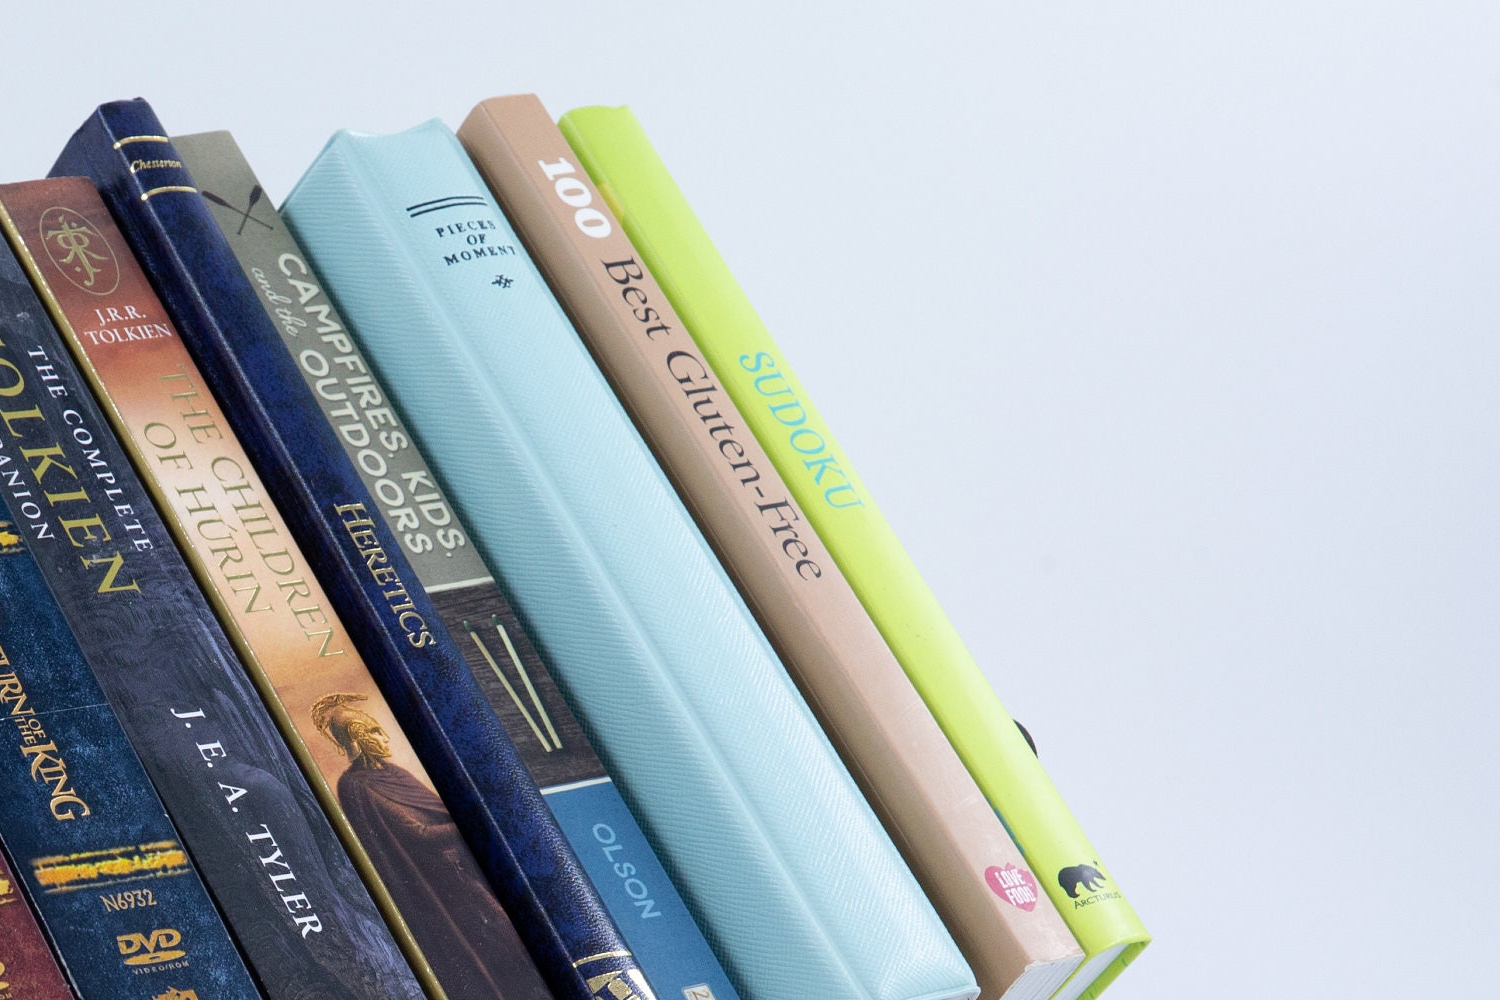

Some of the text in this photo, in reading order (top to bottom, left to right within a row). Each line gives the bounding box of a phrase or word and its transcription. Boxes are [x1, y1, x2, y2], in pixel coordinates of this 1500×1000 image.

[130, 159, 182, 174] Chesterton
[435, 220, 496, 238] PIECES
[466, 234, 486, 245] OF
[443, 245, 516, 266] MOMENT
[94, 305, 148, 326] J.R.R.
[84, 322, 174, 347] TOLKIEN
[537, 156, 822, 583] 100 Best Gluten-Free
[252, 267, 433, 555] and the OUTDOORS
[739, 352, 866, 511] SUDOKU
[28, 346, 153, 554] THE COMPLETE
[144, 422, 274, 614] OF HÚRIN
[160, 364, 348, 658] THE CHILDREN
[333, 502, 437, 650] HERETICS
[15, 716, 37, 746] THE
[28, 717, 47, 739] OF
[19, 740, 91, 821] KING
[170, 708, 323, 939] J. E. A. TYLER
[592, 822, 662, 920] OLSON
[995, 869, 1026, 889] LOVE
[100, 889, 158, 913] N6932
[1005, 886, 1036, 906] FOOD
[1074, 892, 1122, 910] ARCTURUS
[116, 928, 182, 955] DVD
